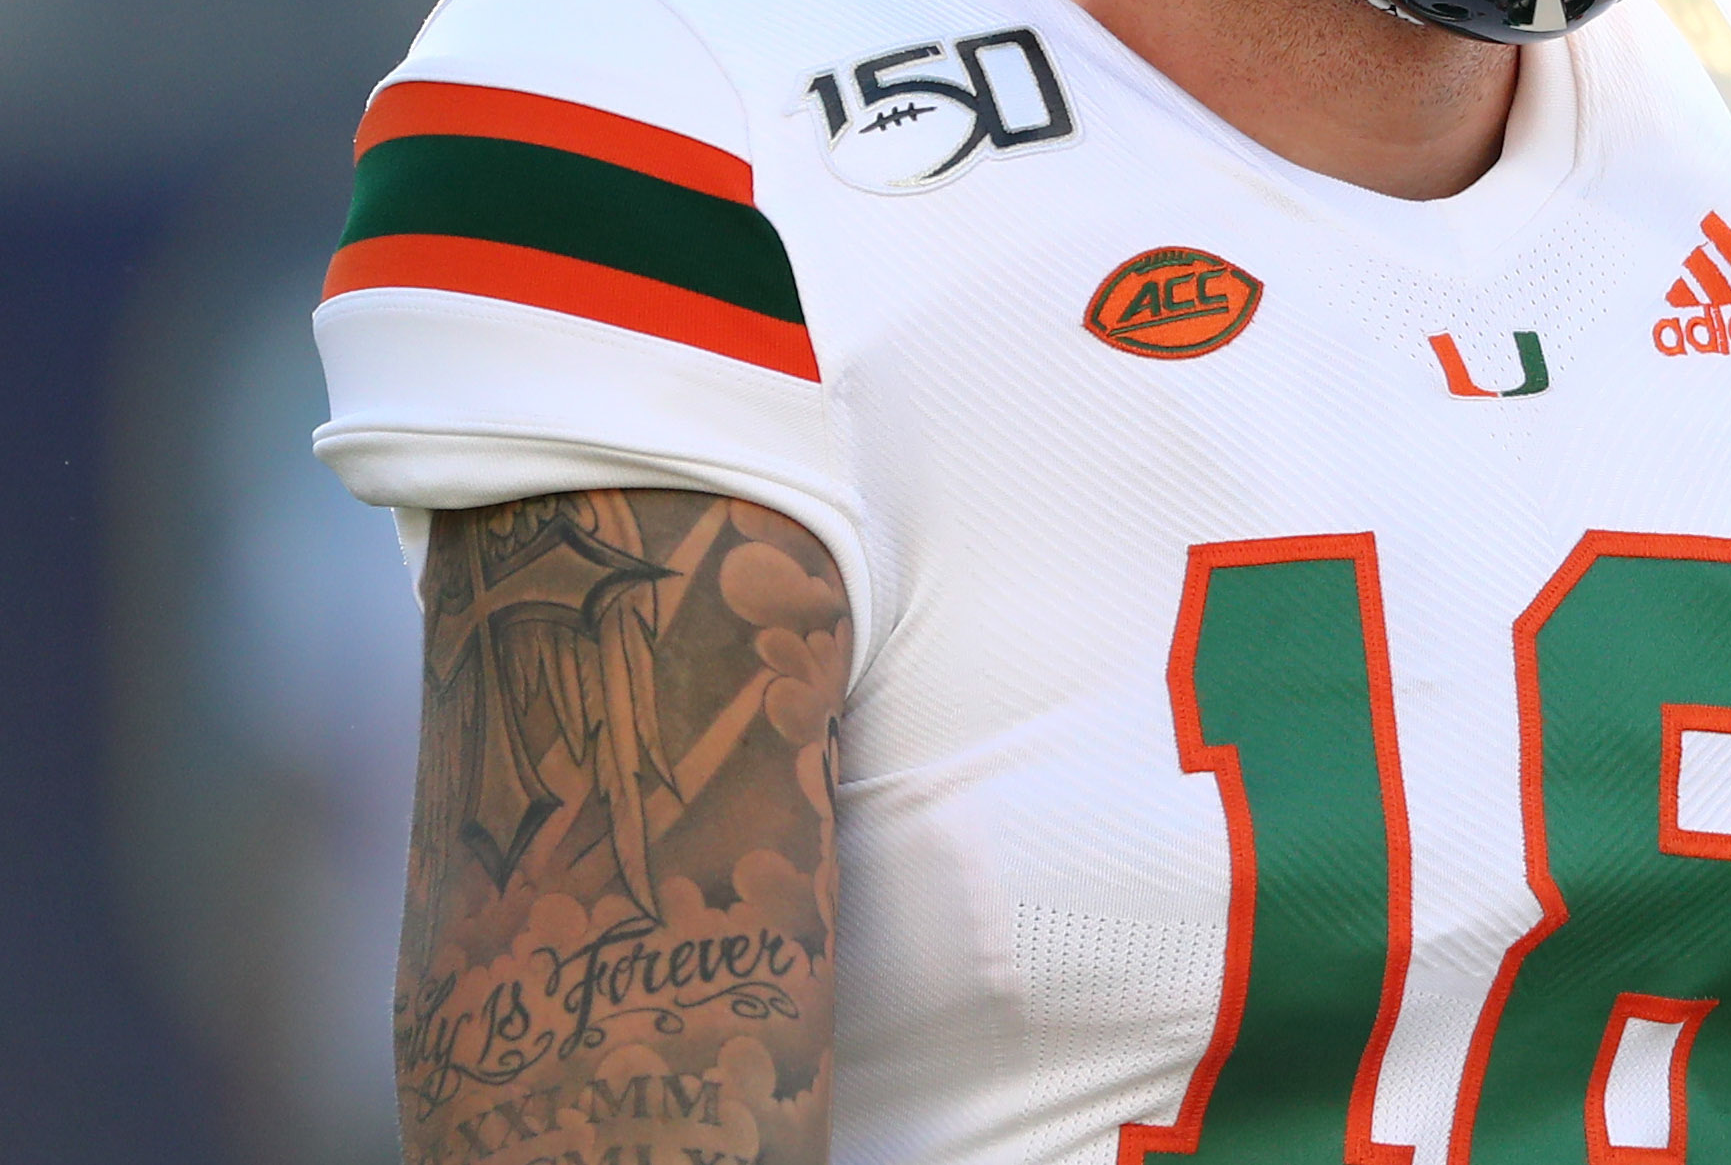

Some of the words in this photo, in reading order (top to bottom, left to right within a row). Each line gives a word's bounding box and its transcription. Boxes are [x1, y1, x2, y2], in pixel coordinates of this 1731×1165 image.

[806, 27, 1075, 180] 150
[1116, 266, 1231, 323] ACC
[1427, 329, 1550, 401] U
[531, 919, 798, 1057] Forever
